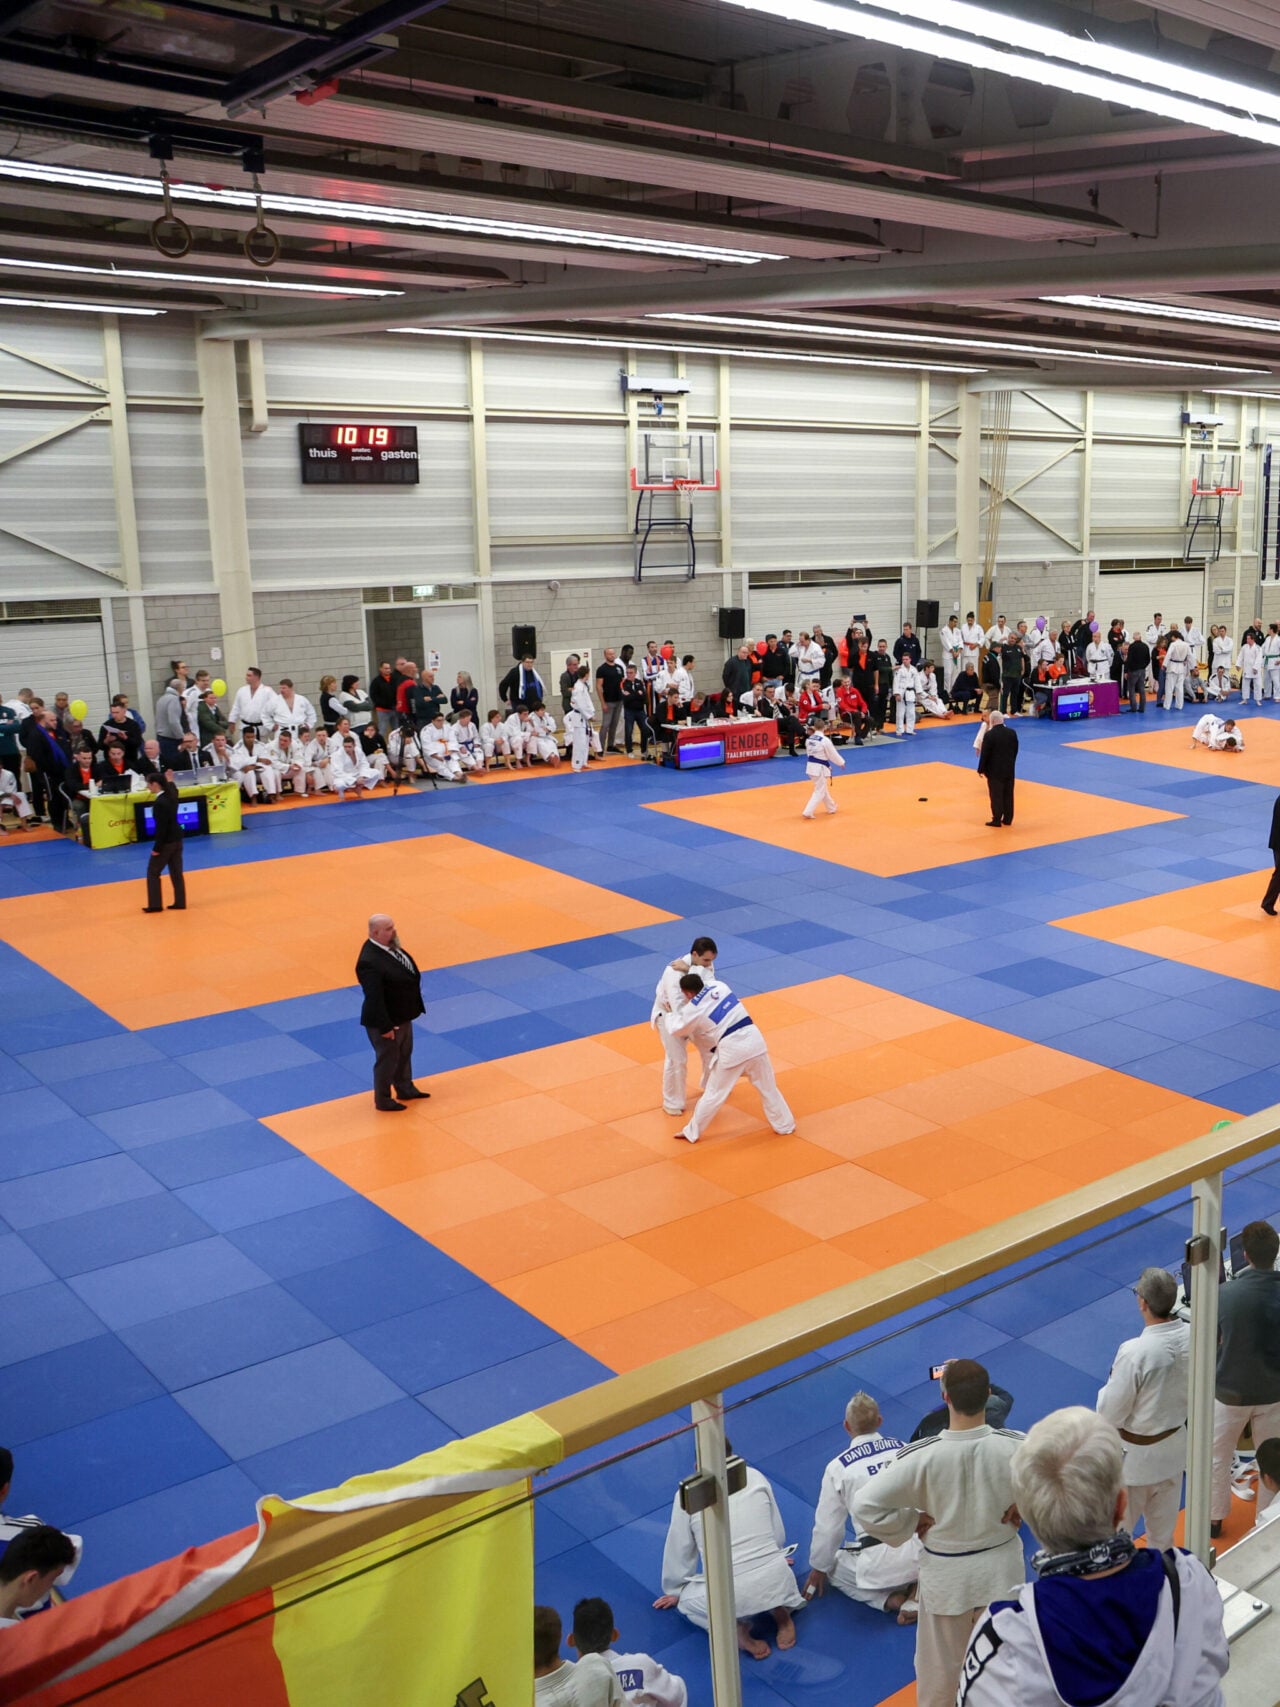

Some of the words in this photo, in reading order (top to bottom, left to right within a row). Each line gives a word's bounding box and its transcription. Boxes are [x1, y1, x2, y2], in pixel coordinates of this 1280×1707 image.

[337, 427, 357, 444] 10
[368, 428, 388, 445] 19
[309, 448, 337, 458] thuis
[381, 450, 417, 460] gasten
[727, 733, 769, 750] IENDER
[726, 749, 769, 759] TAALBEWERKING
[844, 1443, 872, 1463] DAVID
[872, 1439, 901, 1451] BONTE
[621, 1673, 636, 1688] RA
